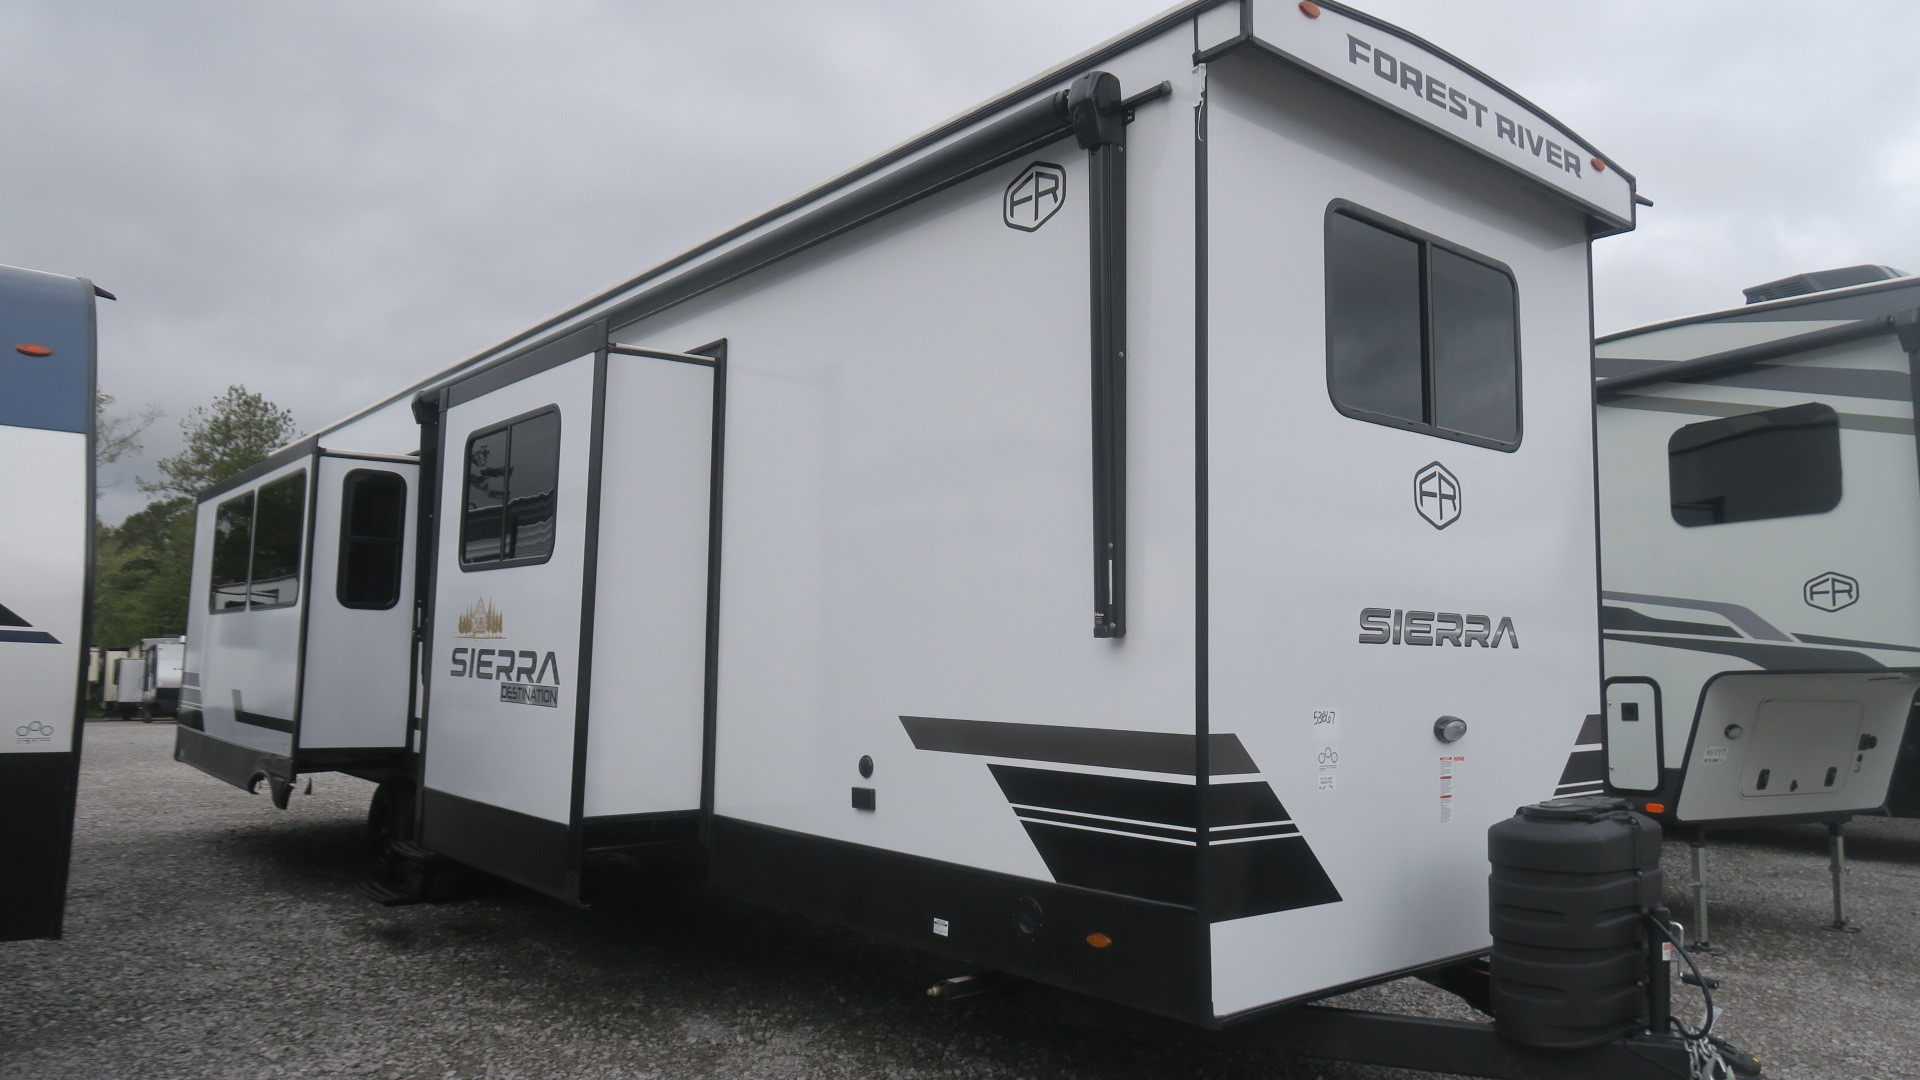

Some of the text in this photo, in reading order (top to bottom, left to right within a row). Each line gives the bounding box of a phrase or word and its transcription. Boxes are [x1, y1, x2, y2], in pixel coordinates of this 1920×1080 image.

[1346, 33, 1582, 179] FOREST RIVER
[1359, 607, 1519, 649] SIERRA
[450, 648, 560, 685] SIERRA
[501, 685, 558, 704] DESTINATION
